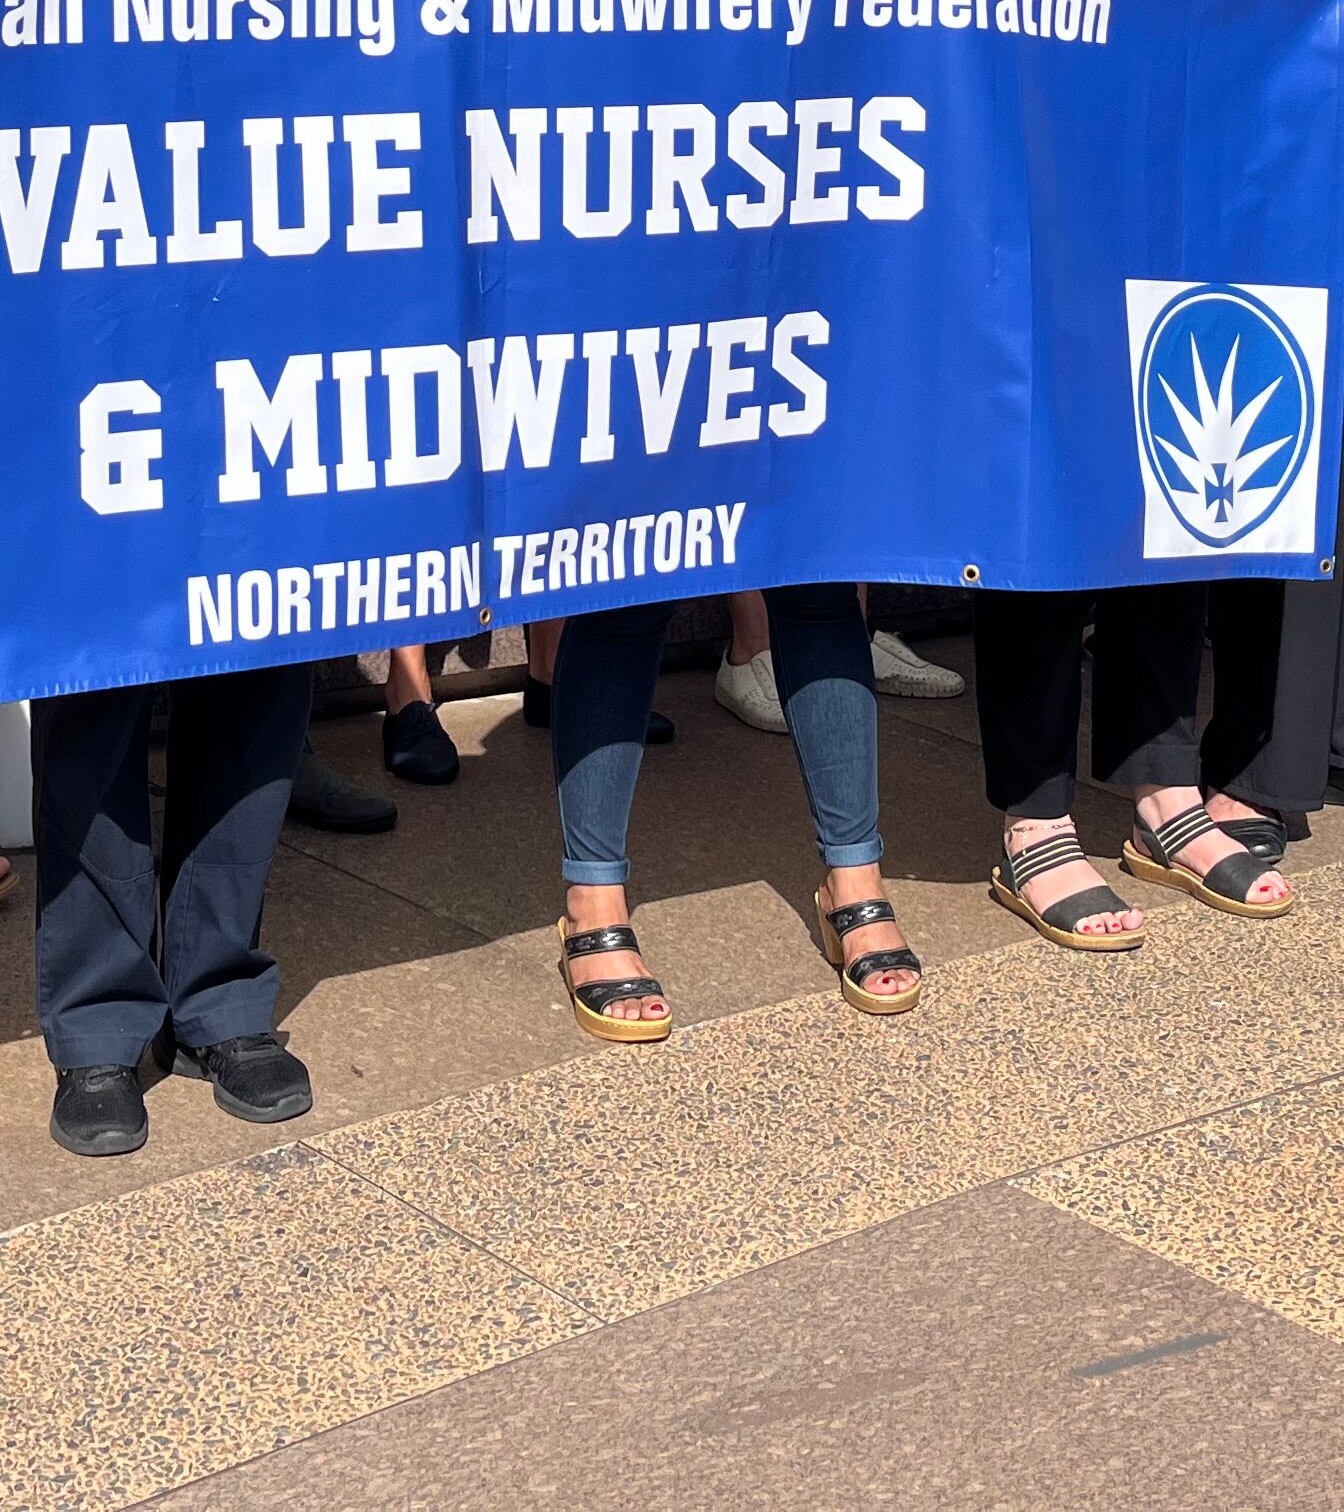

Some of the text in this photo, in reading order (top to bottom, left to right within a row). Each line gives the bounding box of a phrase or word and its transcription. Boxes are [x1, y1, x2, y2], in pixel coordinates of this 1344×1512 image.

[466, 96, 926, 244] NURSES
[79, 310, 830, 516] & MIDWIVES
[187, 502, 747, 646] NORTHERN TERRITORY
